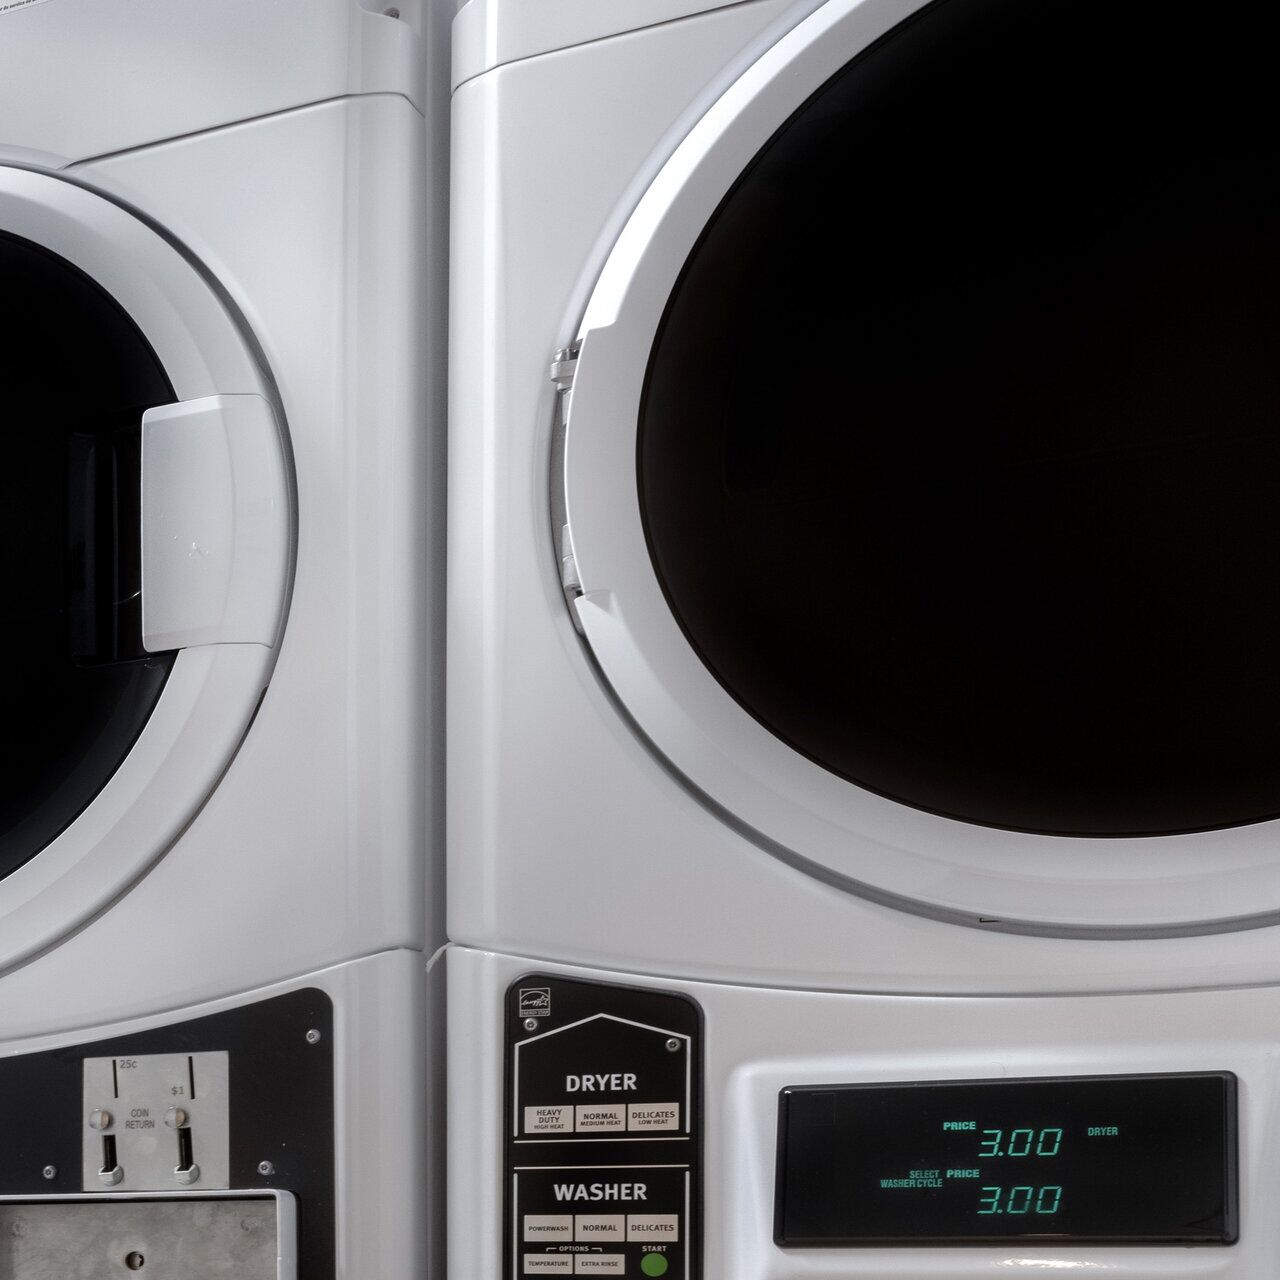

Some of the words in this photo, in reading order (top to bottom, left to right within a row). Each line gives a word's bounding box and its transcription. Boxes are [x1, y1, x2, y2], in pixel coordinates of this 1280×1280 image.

[566, 1073, 637, 1092] DRYER
[171, 1086, 184, 1095] $1
[131, 1109, 149, 1118] COIN
[632, 1111, 676, 1119] DELICATES
[125, 1120, 155, 1129] RETURN
[943, 1121, 976, 1131] PRICE
[1088, 1127, 1119, 1136] DRYER
[978, 1128, 1063, 1157] 3.00
[910, 1170, 940, 1179] SELECT
[946, 1169, 980, 1178] PRICE
[880, 1179, 916, 1188] WASHER
[917, 1179, 943, 1188] CYCLE
[554, 1183, 647, 1201] WASHER
[977, 1186, 1062, 1214] 3.00
